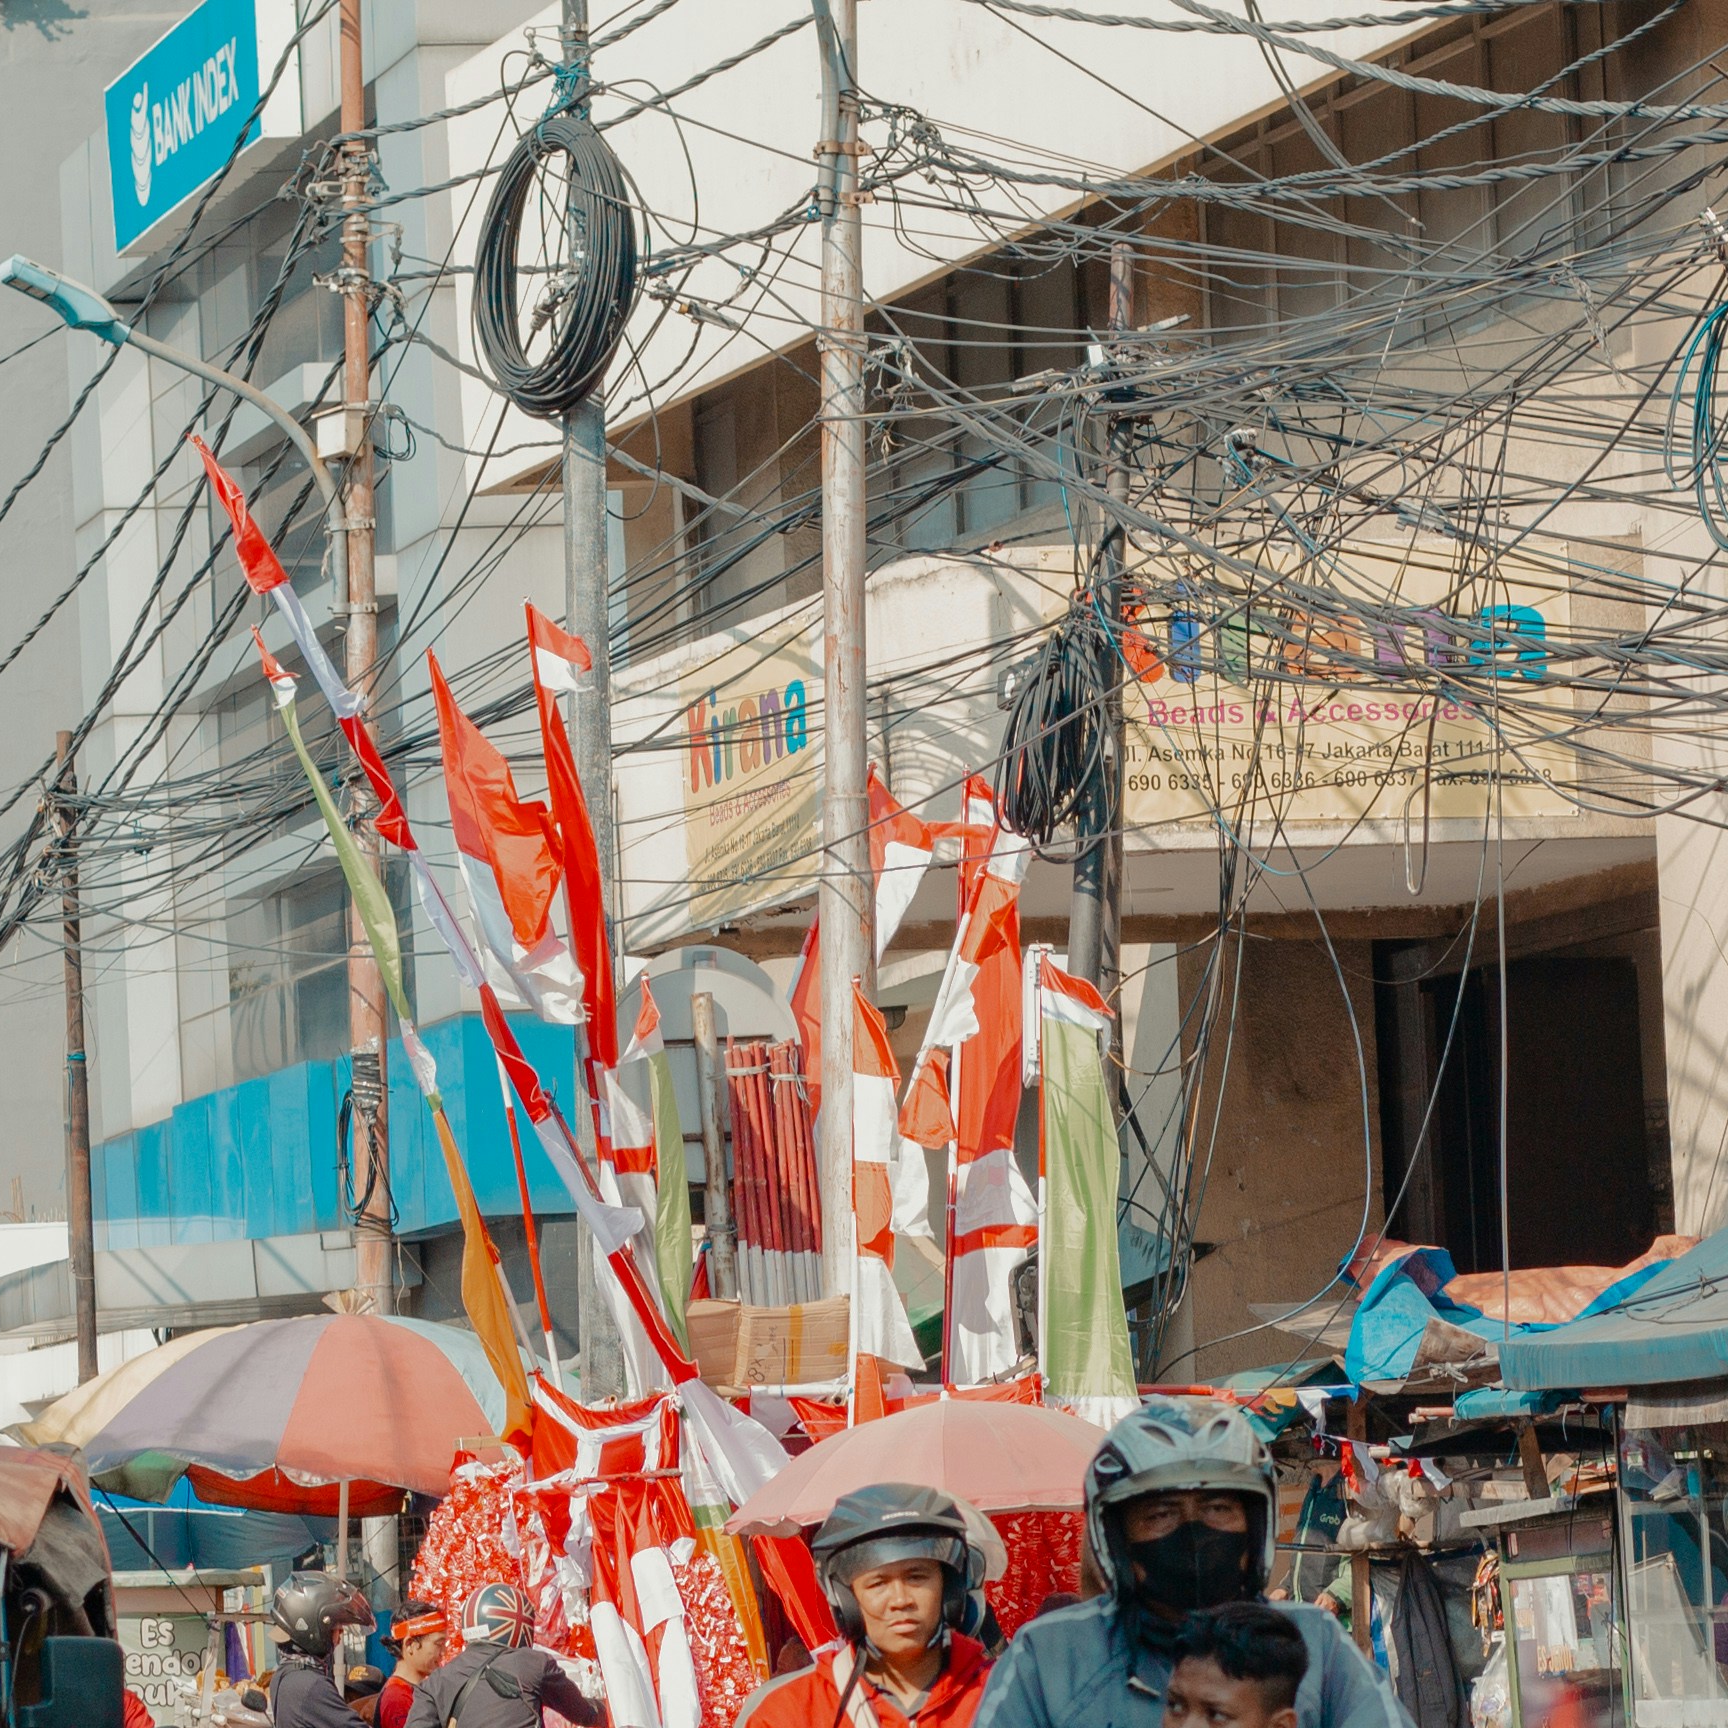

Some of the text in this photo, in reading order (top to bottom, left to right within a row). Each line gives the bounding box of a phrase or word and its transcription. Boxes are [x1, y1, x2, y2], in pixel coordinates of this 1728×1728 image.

[151, 36, 239, 167] BANK INDEX
[1147, 698, 1245, 727] Beads
[1286, 697, 1478, 723] Accessories
[687, 678, 808, 794] Kirana
[1147, 745, 1225, 763] Asemka
[1232, 742, 1315, 762] No.16-7
[1321, 740, 1393, 760] Jakarta
[1399, 740, 1450, 758] Baat
[1456, 739, 1507, 757] 111
[1127, 774, 1162, 792] 690
[1168, 772, 1213, 791] 6335
[1334, 770, 1367, 788] 690
[1373, 768, 1418, 787] 6337
[140, 1616, 175, 1649] Es
[125, 1648, 208, 1678] endol
